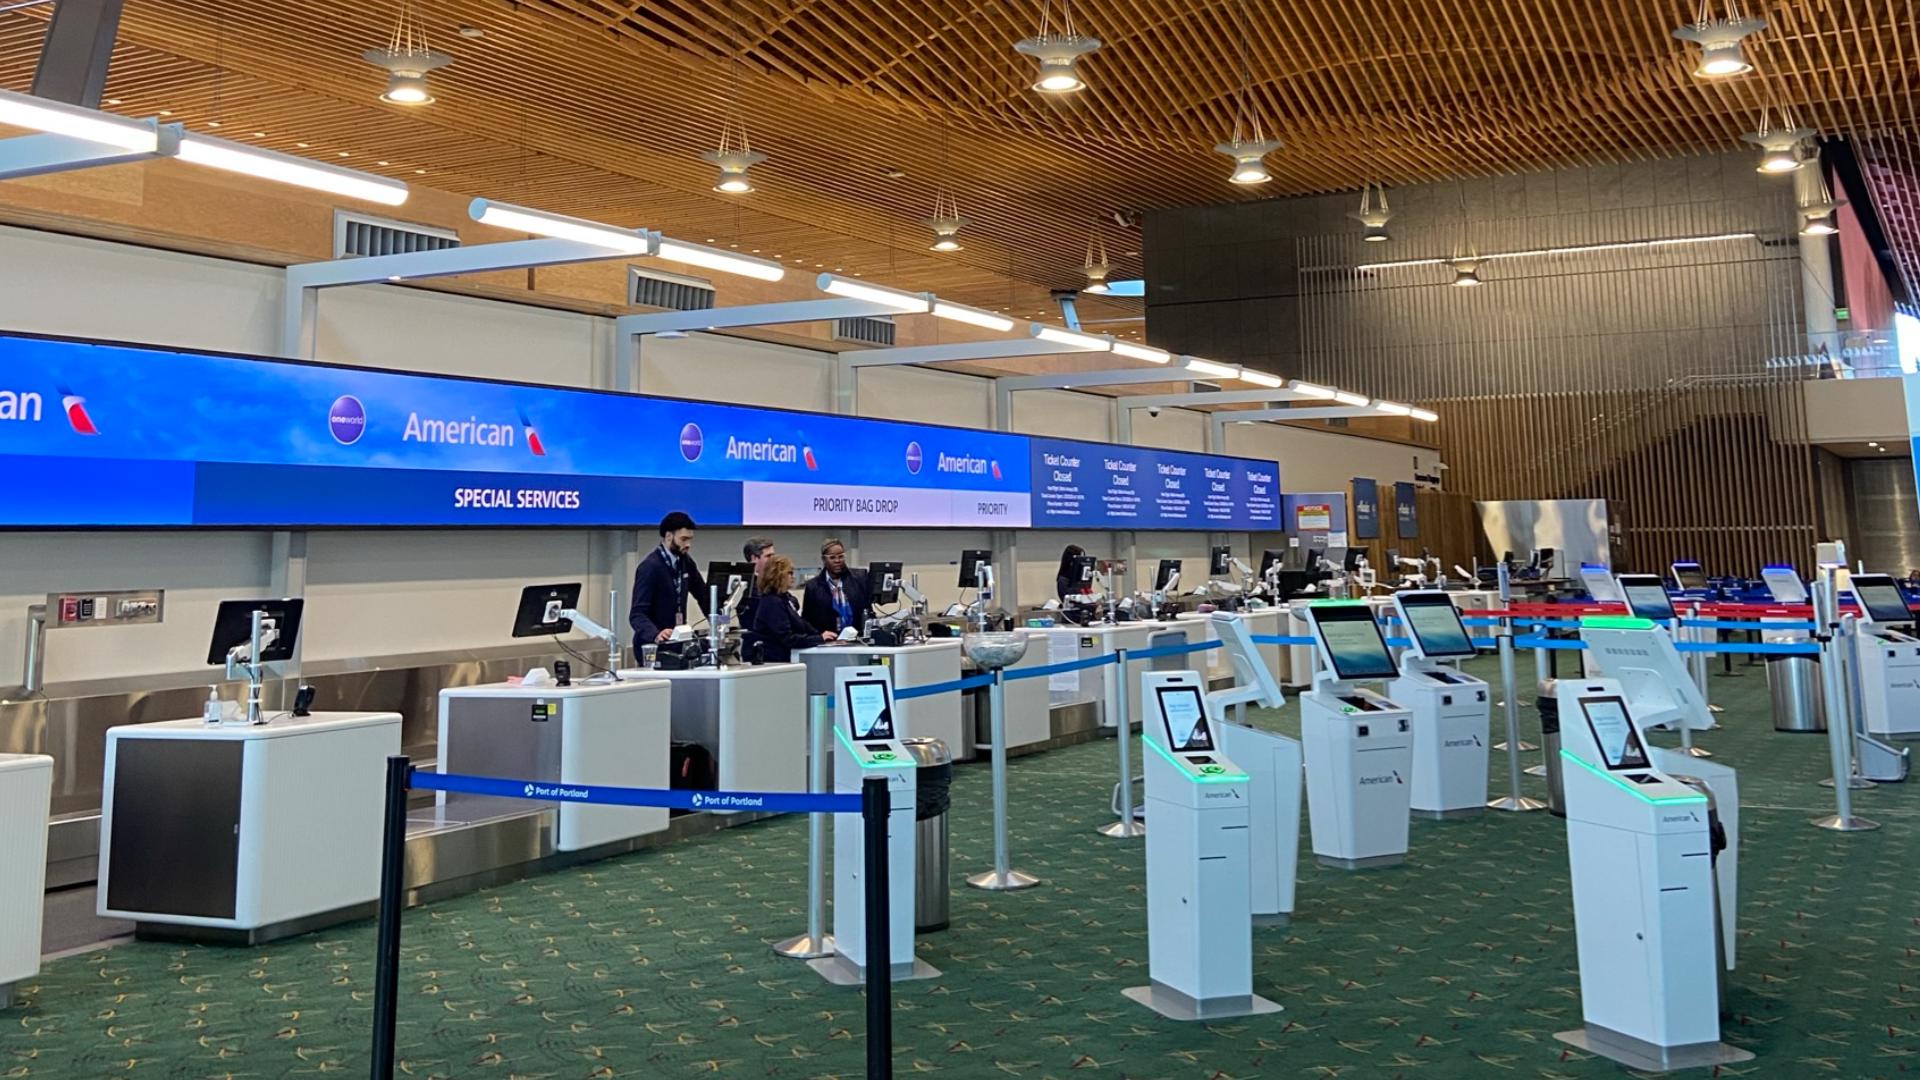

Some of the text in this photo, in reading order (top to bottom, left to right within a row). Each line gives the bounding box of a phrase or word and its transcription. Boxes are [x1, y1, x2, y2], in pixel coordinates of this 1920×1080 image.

[402, 412, 514, 447] American
[725, 435, 797, 462] American
[937, 451, 988, 474] American
[454, 488, 580, 509] SPECIAL SERVICES
[813, 497, 899, 513] PRIORITY BAG DROP
[977, 502, 1009, 515] PRIORITY
[1359, 775, 1393, 785] American
[535, 786, 589, 799] Port of Portland
[705, 795, 763, 806] Port of Portland
